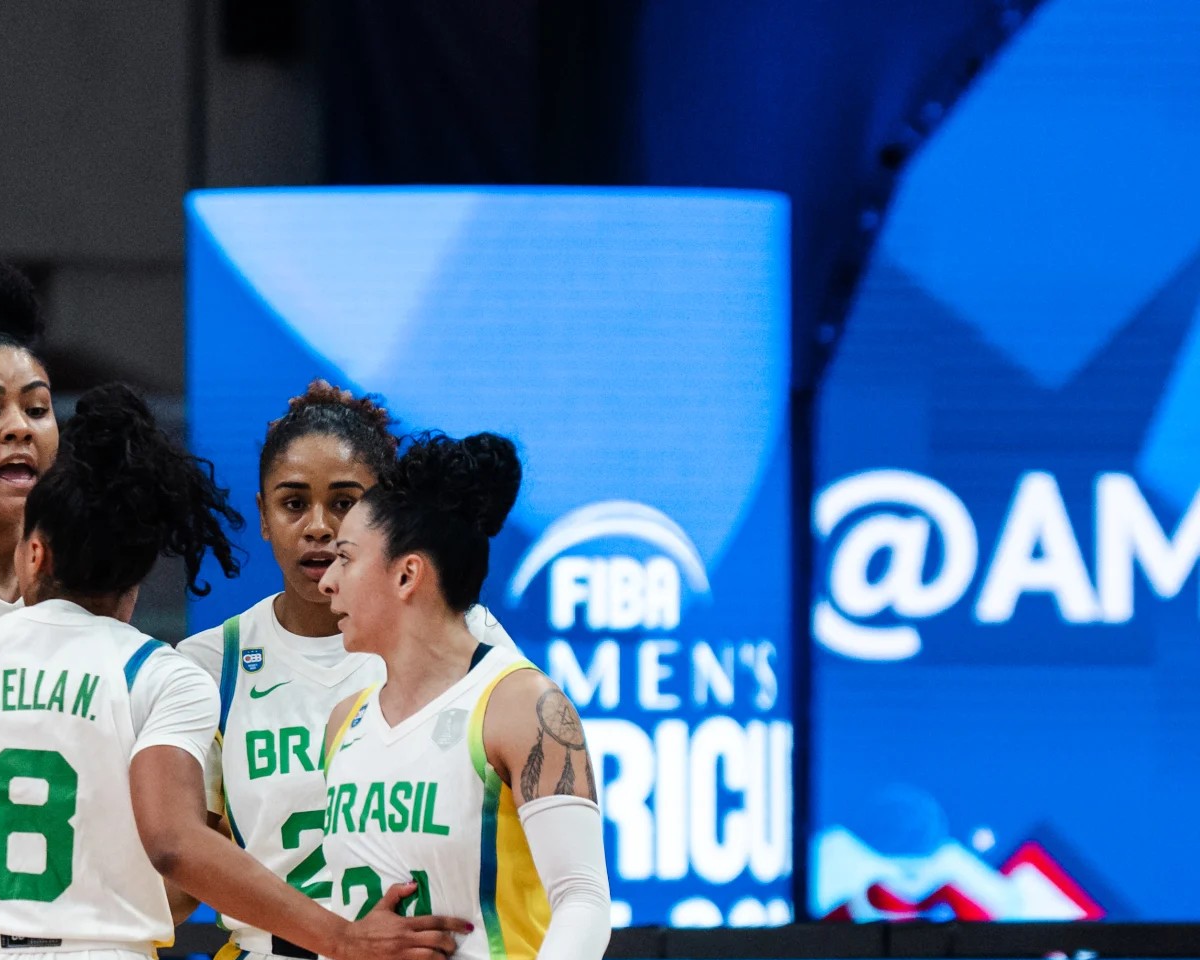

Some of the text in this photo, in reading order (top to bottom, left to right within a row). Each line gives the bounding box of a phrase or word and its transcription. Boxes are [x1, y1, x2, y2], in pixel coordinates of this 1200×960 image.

[550, 555, 681, 631] FIBA
[71, 673, 100, 721] N.
[246, 724, 327, 780] BR
[324, 781, 450, 836] BRASIL
[581, 715, 793, 883] RICU
